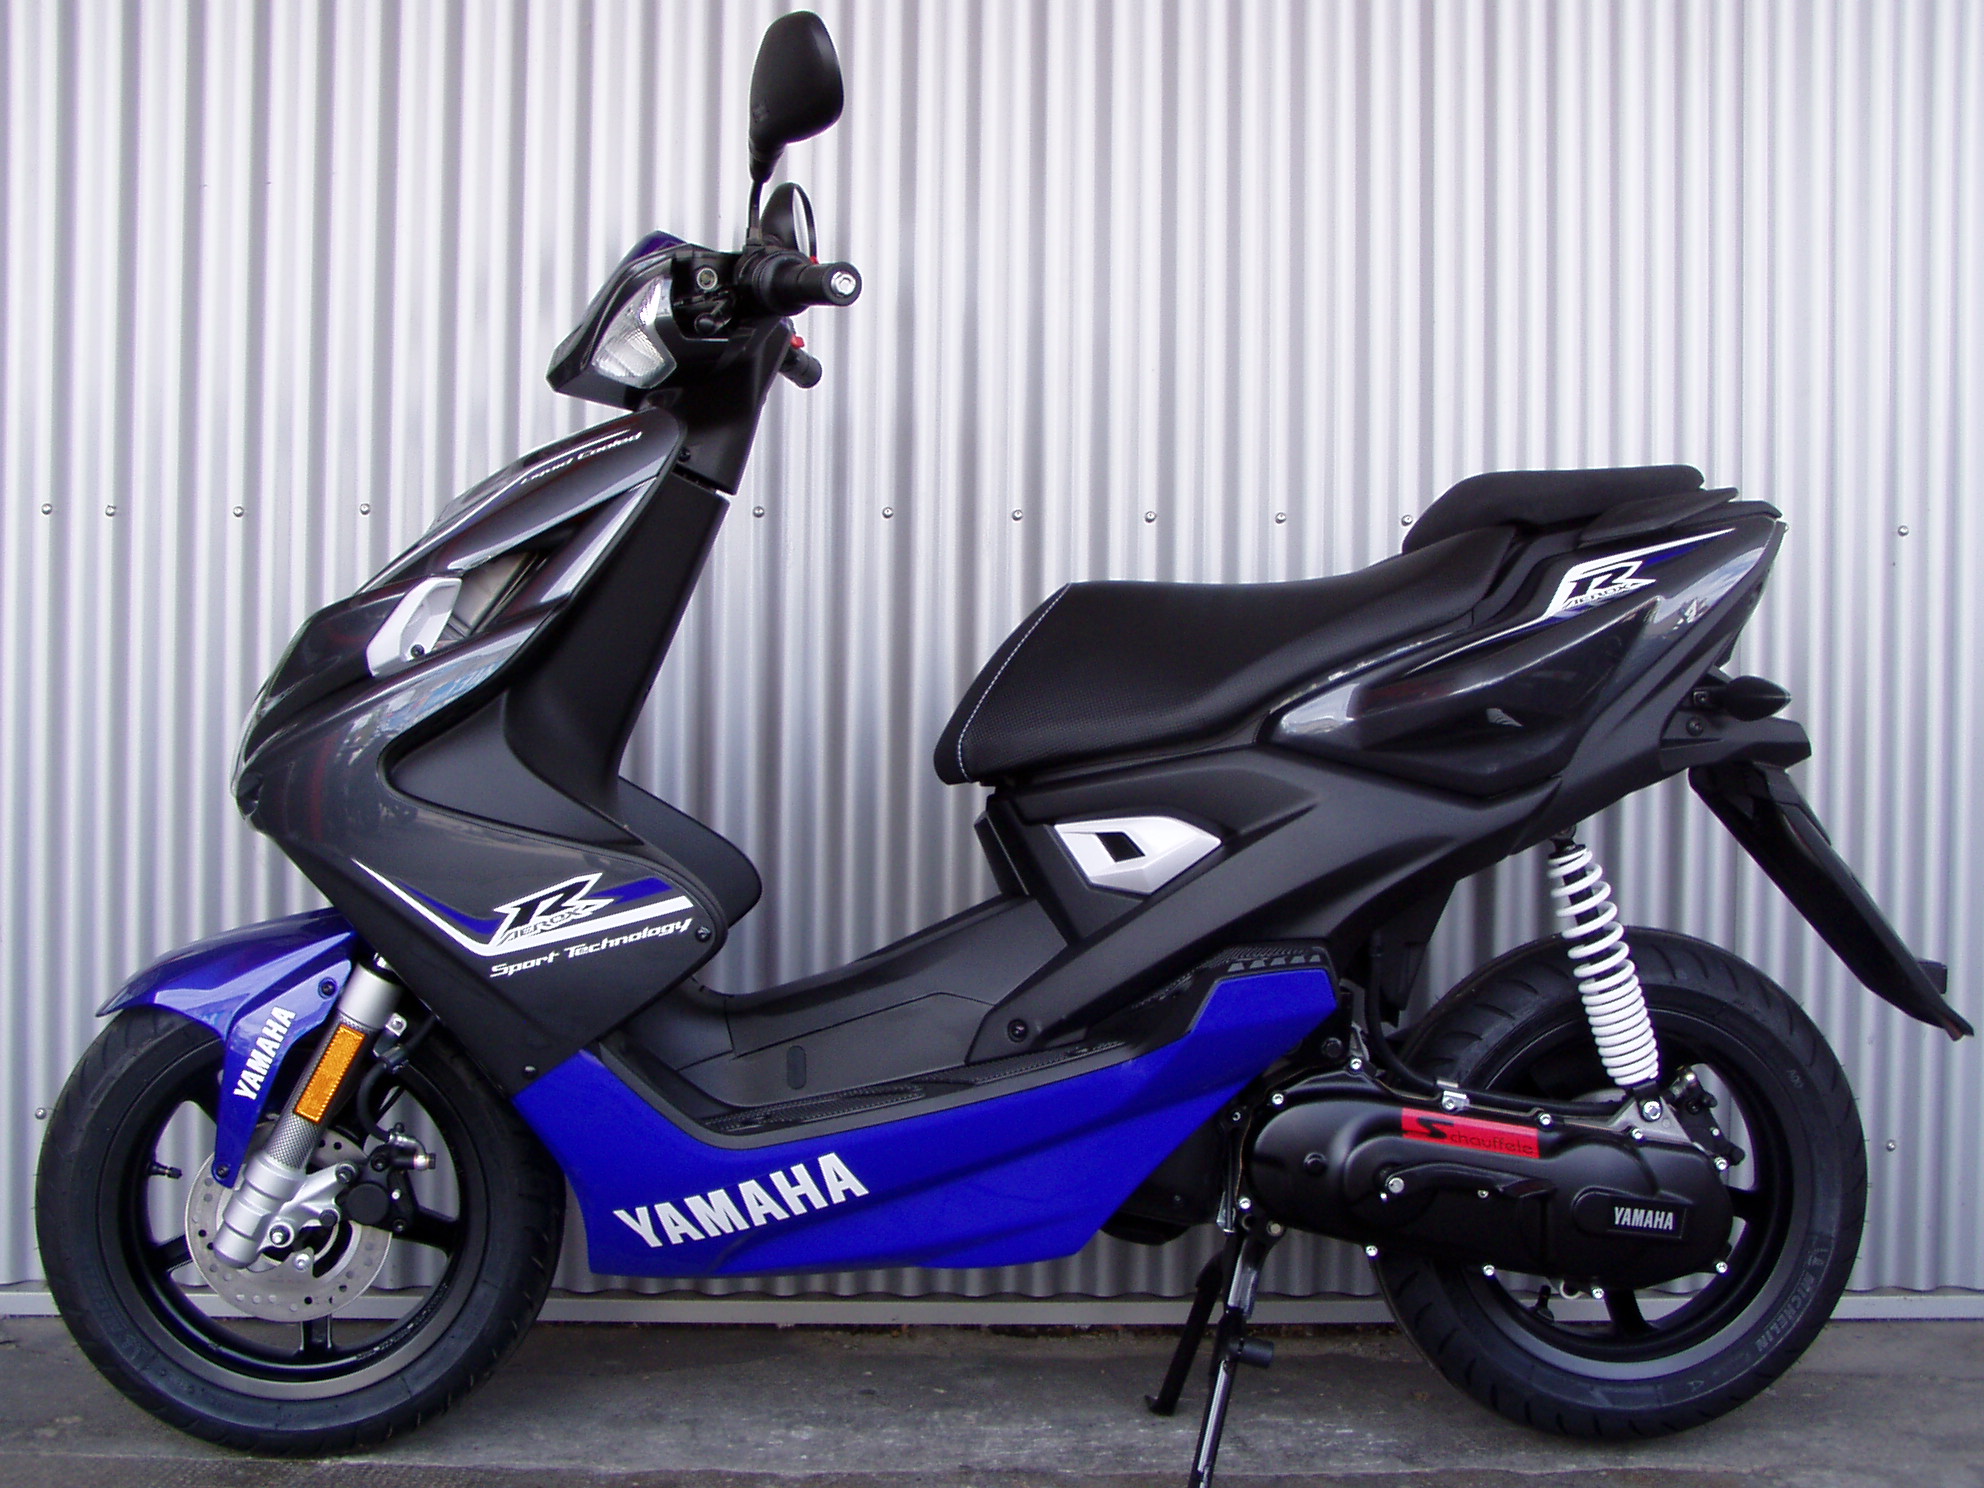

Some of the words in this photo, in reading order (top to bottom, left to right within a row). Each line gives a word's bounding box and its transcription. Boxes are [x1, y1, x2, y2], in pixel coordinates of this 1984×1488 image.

[489, 951, 560, 978] Sport
[563, 917, 694, 959] Technology
[233, 1006, 296, 1100] YAMAHA
[612, 1151, 870, 1248] YAMAHA
[1613, 1206, 1674, 1230] YAMAHA
[1755, 1271, 1816, 1352] MICHELIN
